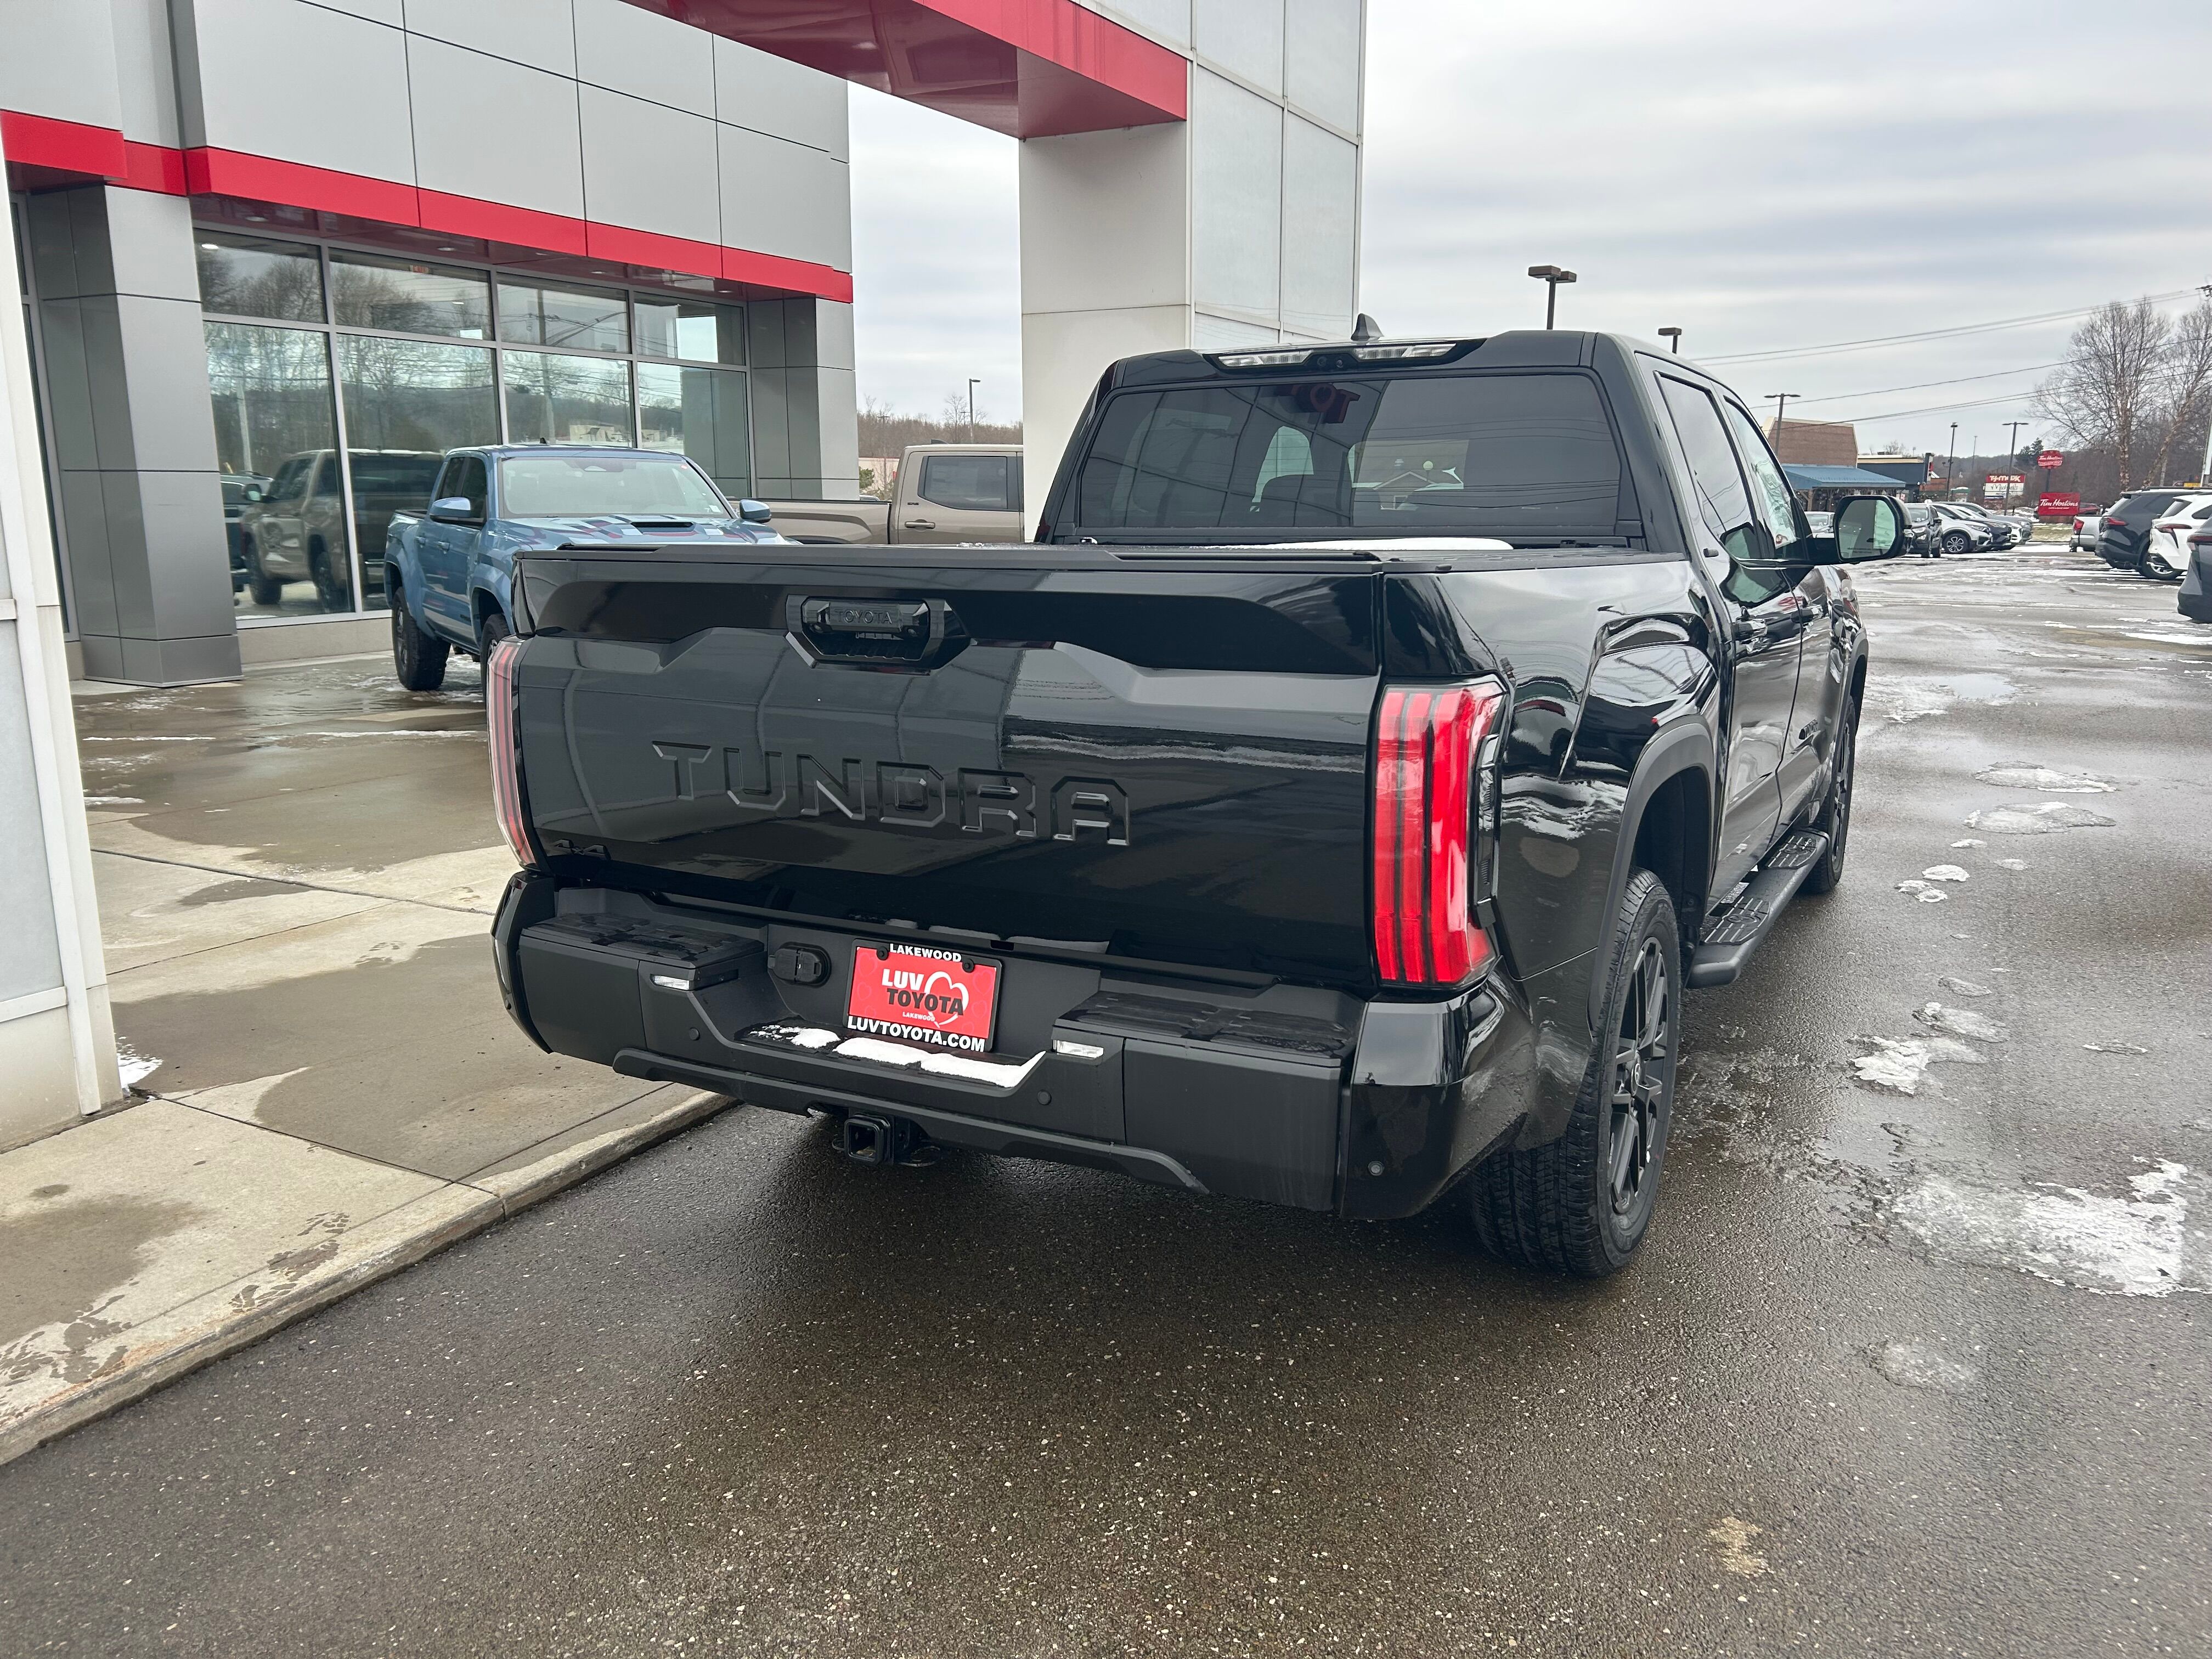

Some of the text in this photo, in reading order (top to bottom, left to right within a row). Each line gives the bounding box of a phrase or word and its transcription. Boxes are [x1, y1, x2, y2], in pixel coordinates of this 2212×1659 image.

[834, 609, 893, 624] TOYOTA
[652, 740, 1131, 847] TUNDRA
[889, 943, 962, 962] LAKEWOOD
[881, 968, 925, 991] LUV
[886, 989, 964, 1015] TOYOTA
[902, 1012, 935, 1022] LAKEWOOD
[847, 1015, 985, 1053] LUVTOYOTA.COM
